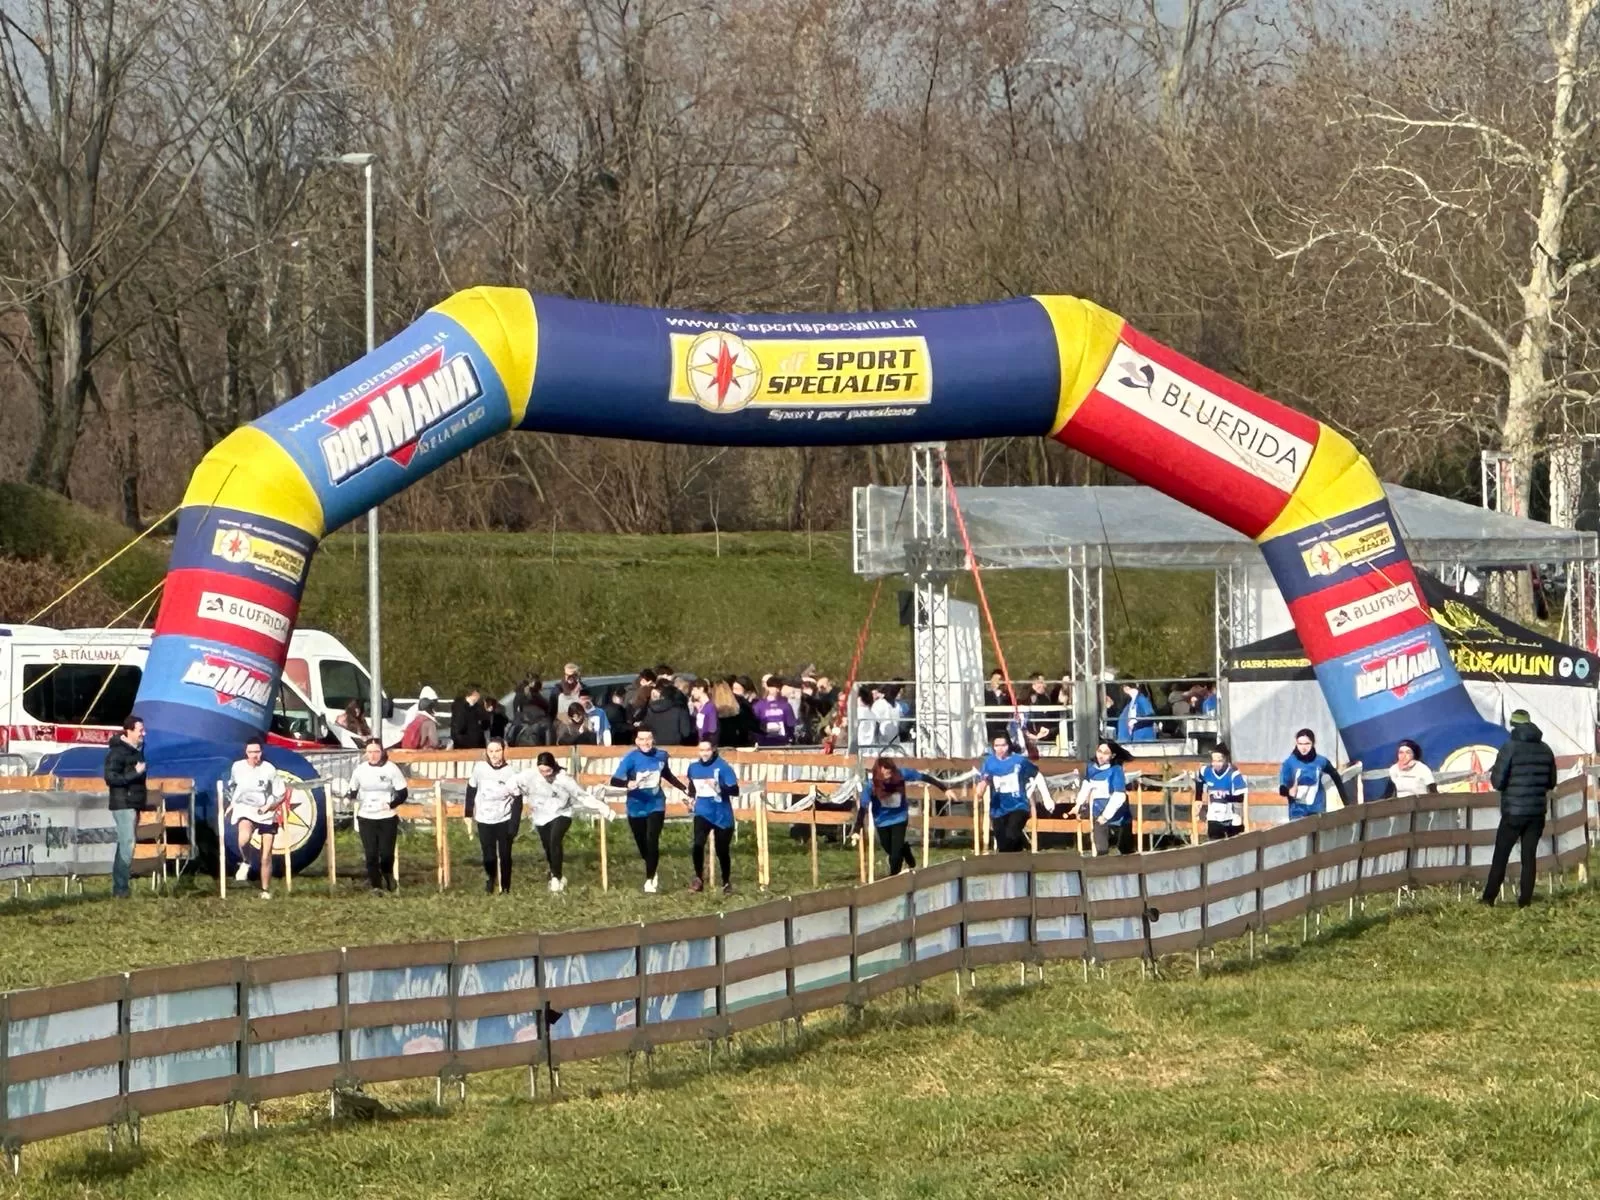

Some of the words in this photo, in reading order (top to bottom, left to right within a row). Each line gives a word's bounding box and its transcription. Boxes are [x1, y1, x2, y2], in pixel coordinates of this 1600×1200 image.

[817, 349, 917, 371] SPORT
[288, 330, 449, 432] www.bicimania.it
[767, 373, 919, 395] SPECIALIST
[817, 410, 846, 420] per
